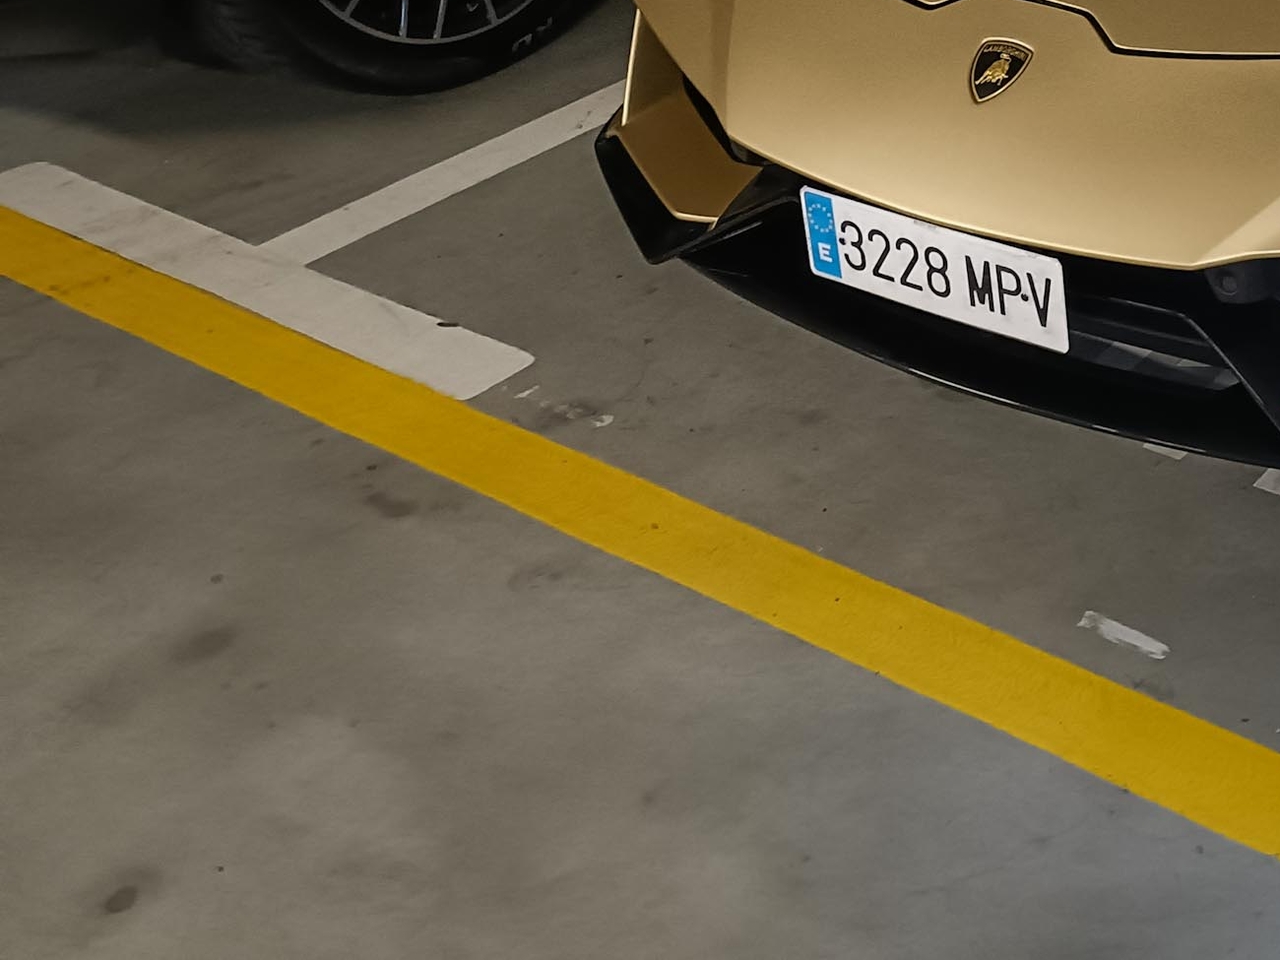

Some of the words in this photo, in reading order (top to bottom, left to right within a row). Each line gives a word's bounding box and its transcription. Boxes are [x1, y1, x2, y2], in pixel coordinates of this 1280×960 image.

[818, 242, 833, 263] E
[840, 220, 951, 298] 3228
[965, 255, 1052, 328] MPV
